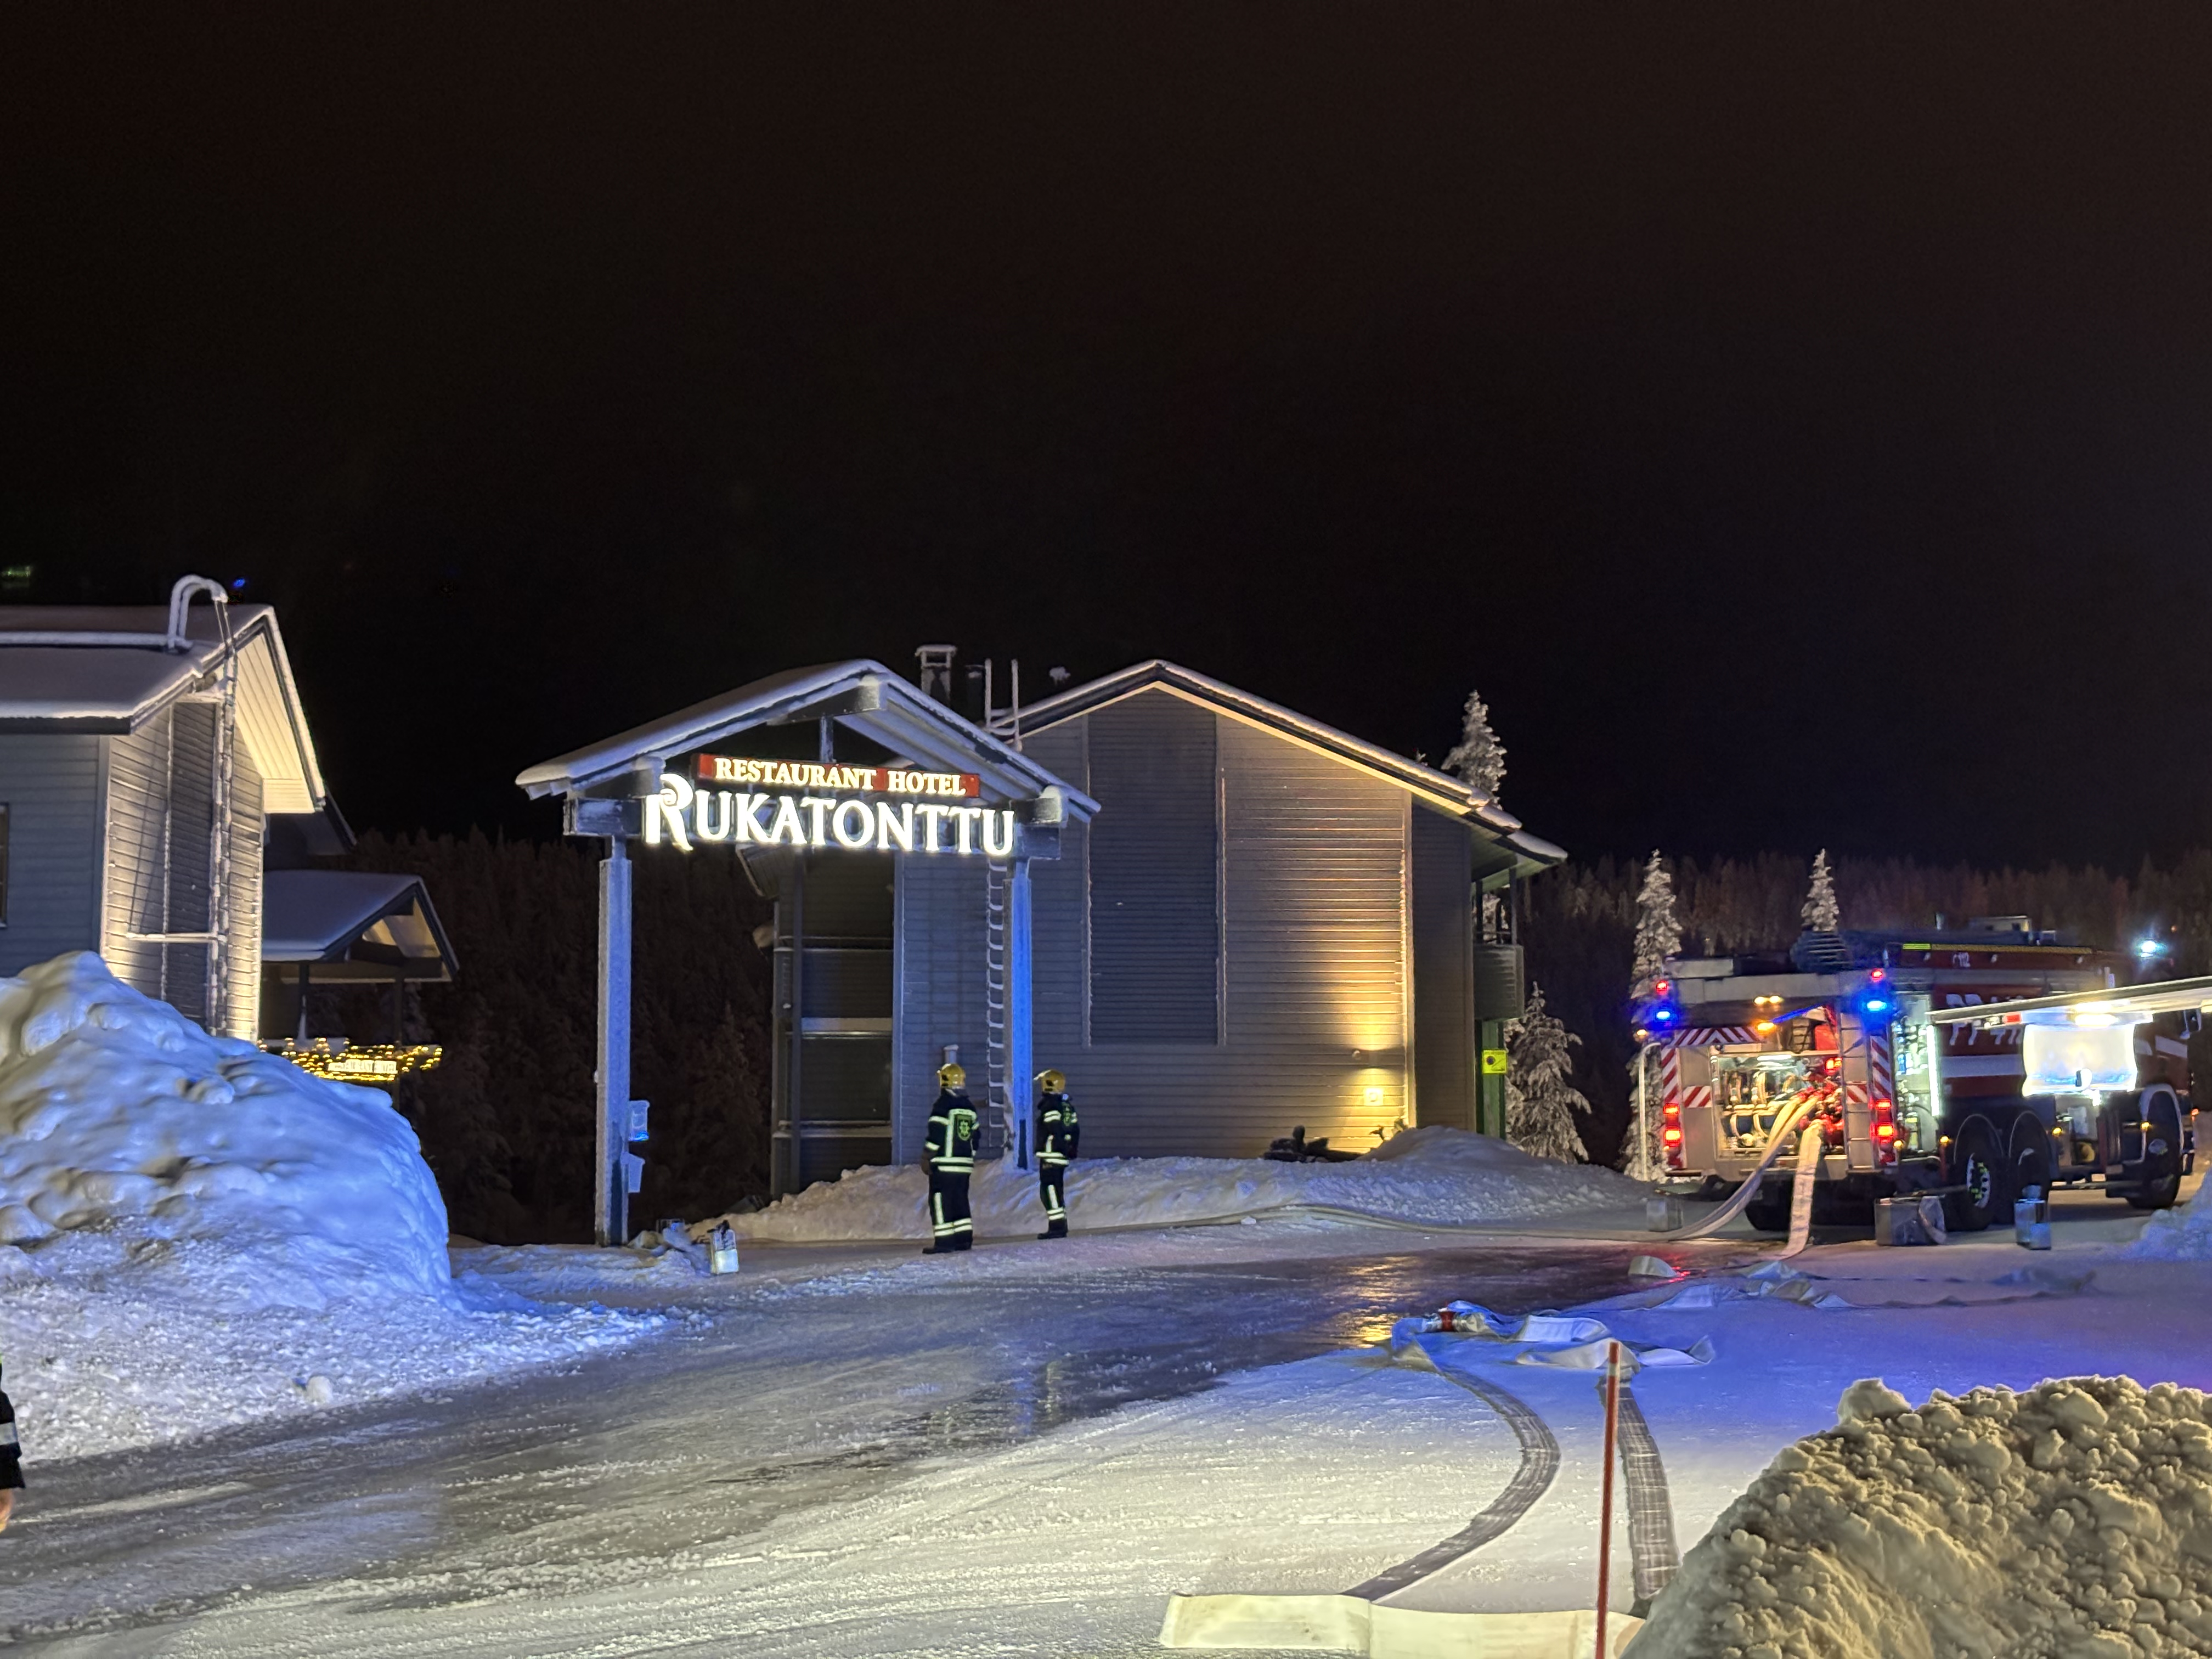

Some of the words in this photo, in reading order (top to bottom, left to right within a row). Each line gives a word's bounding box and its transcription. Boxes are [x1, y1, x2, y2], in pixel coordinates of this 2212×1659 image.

[715, 758, 877, 791] RESTAURANT
[887, 770, 966, 795] HOTEL
[644, 774, 1015, 855] RUKATONTTU
